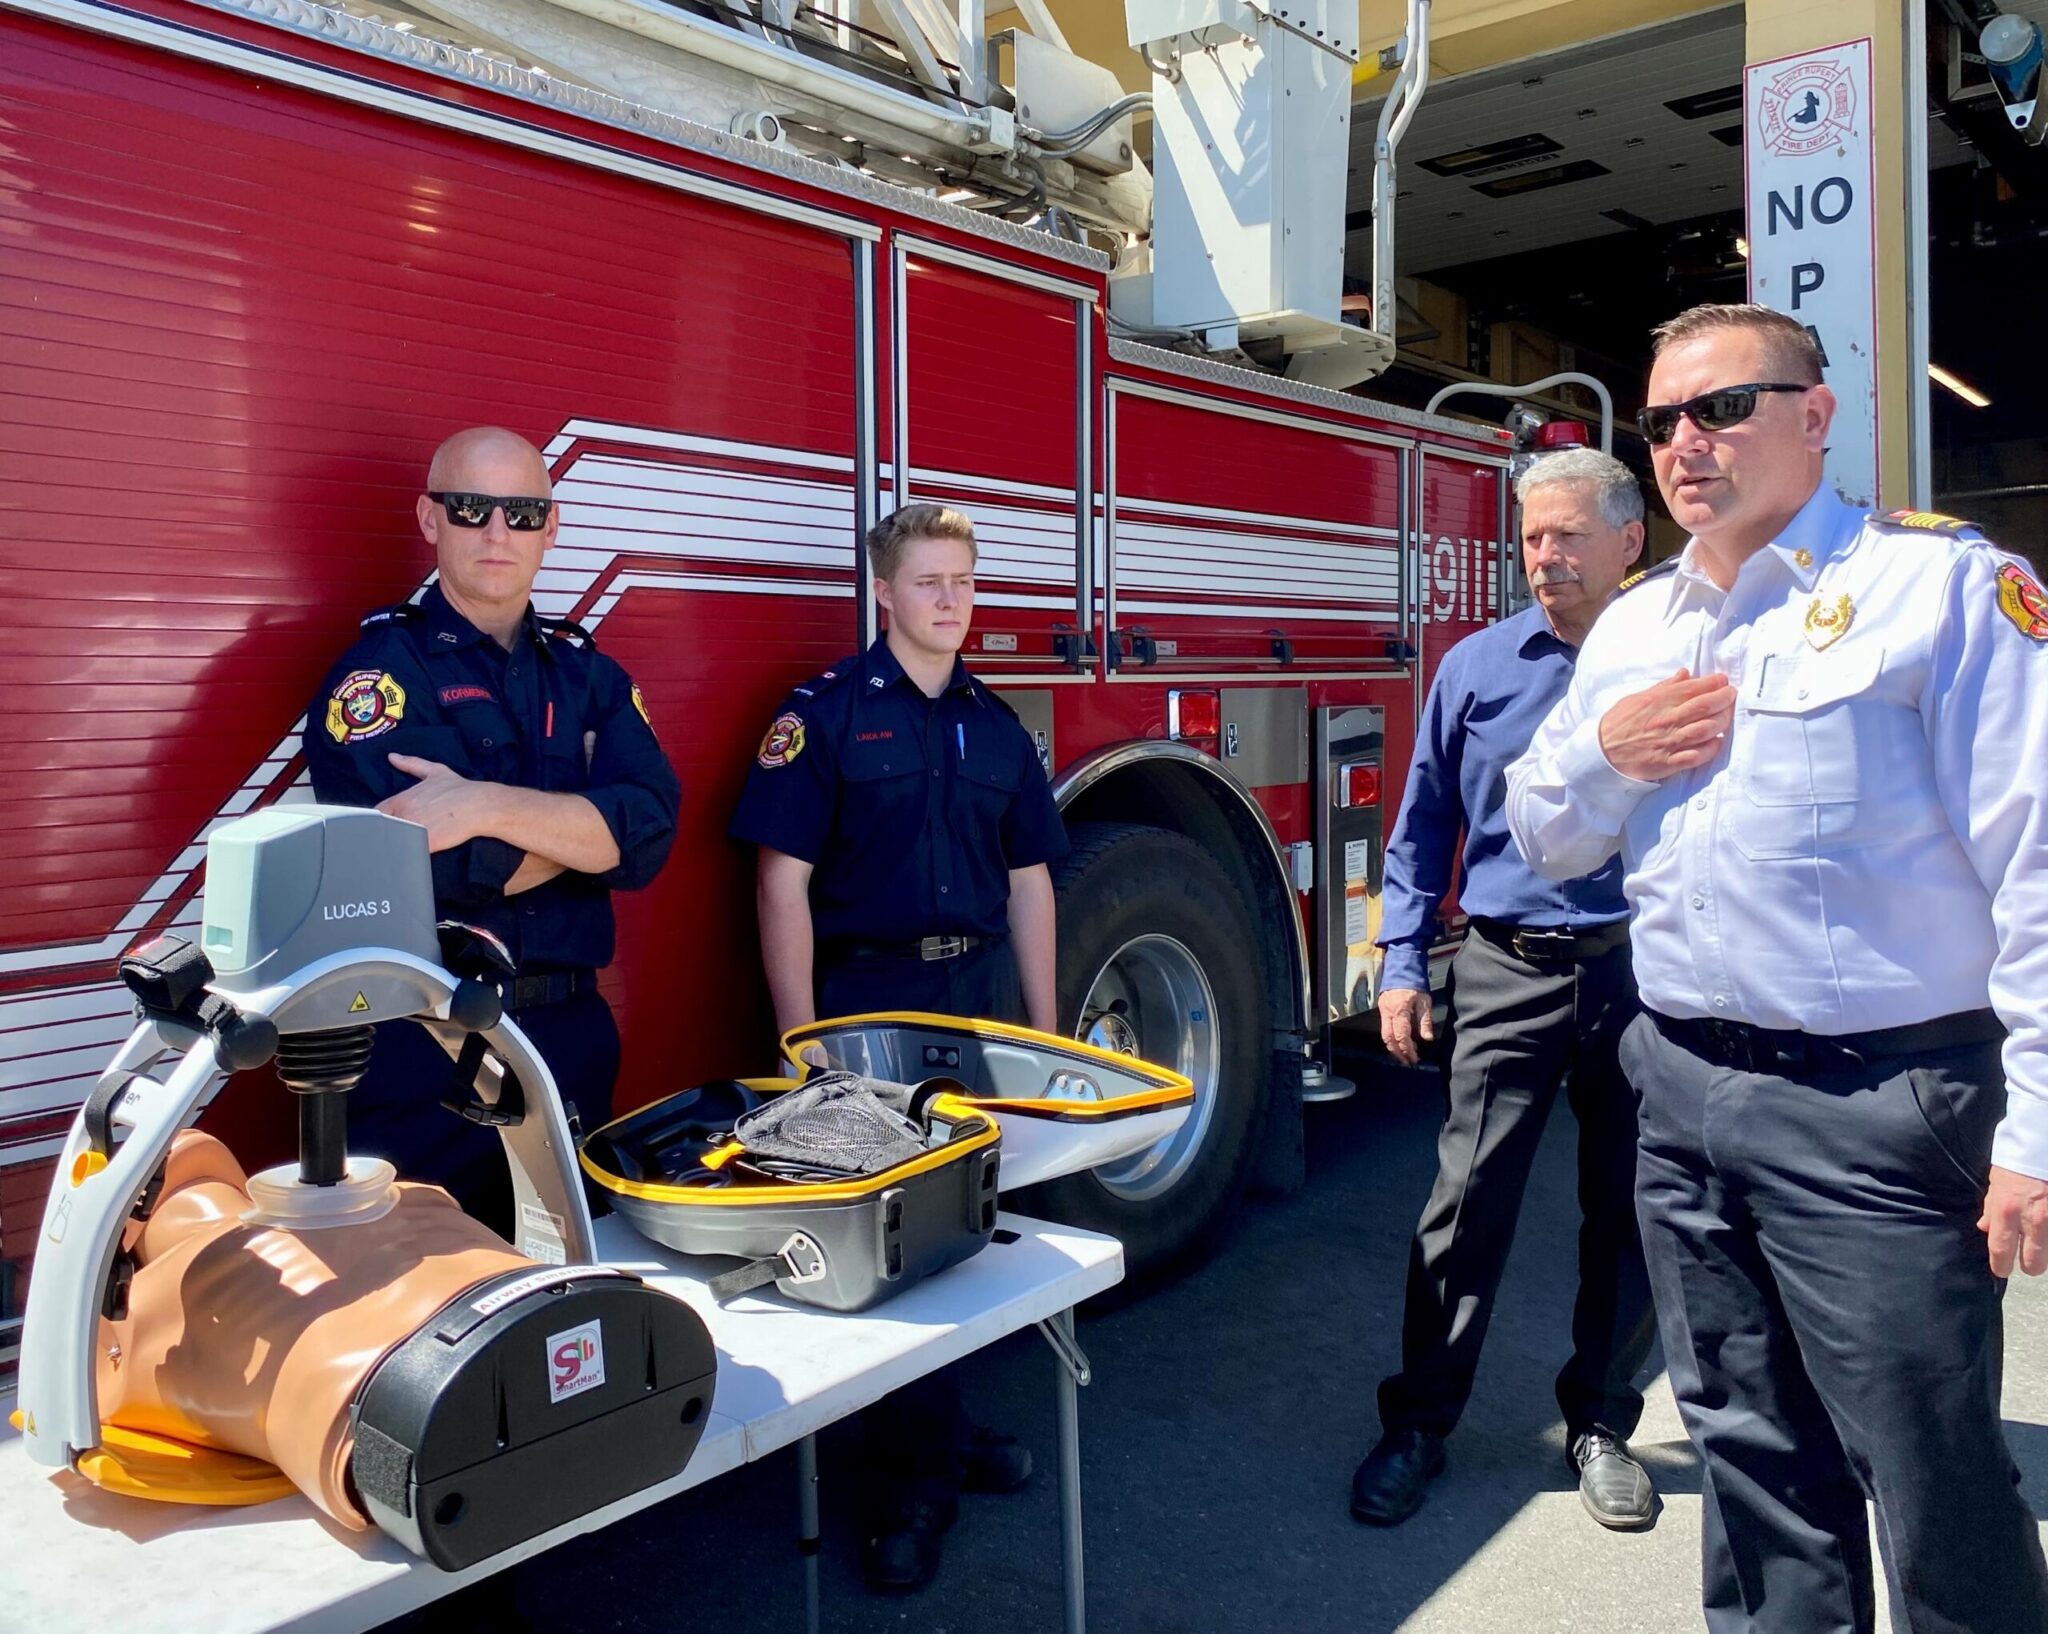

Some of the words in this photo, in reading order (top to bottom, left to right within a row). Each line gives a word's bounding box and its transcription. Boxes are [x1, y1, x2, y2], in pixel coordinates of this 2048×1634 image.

[1776, 68, 1802, 94] PRINCE
[1805, 66, 1836, 81] RUPERT
[1783, 140, 1802, 149] FIRE
[1768, 177, 1853, 236] NO
[1433, 536, 1483, 622] 911
[324, 901, 378, 920] LUCAS
[381, 900, 391, 914] 3
[480, 1281, 531, 1311] Airway
